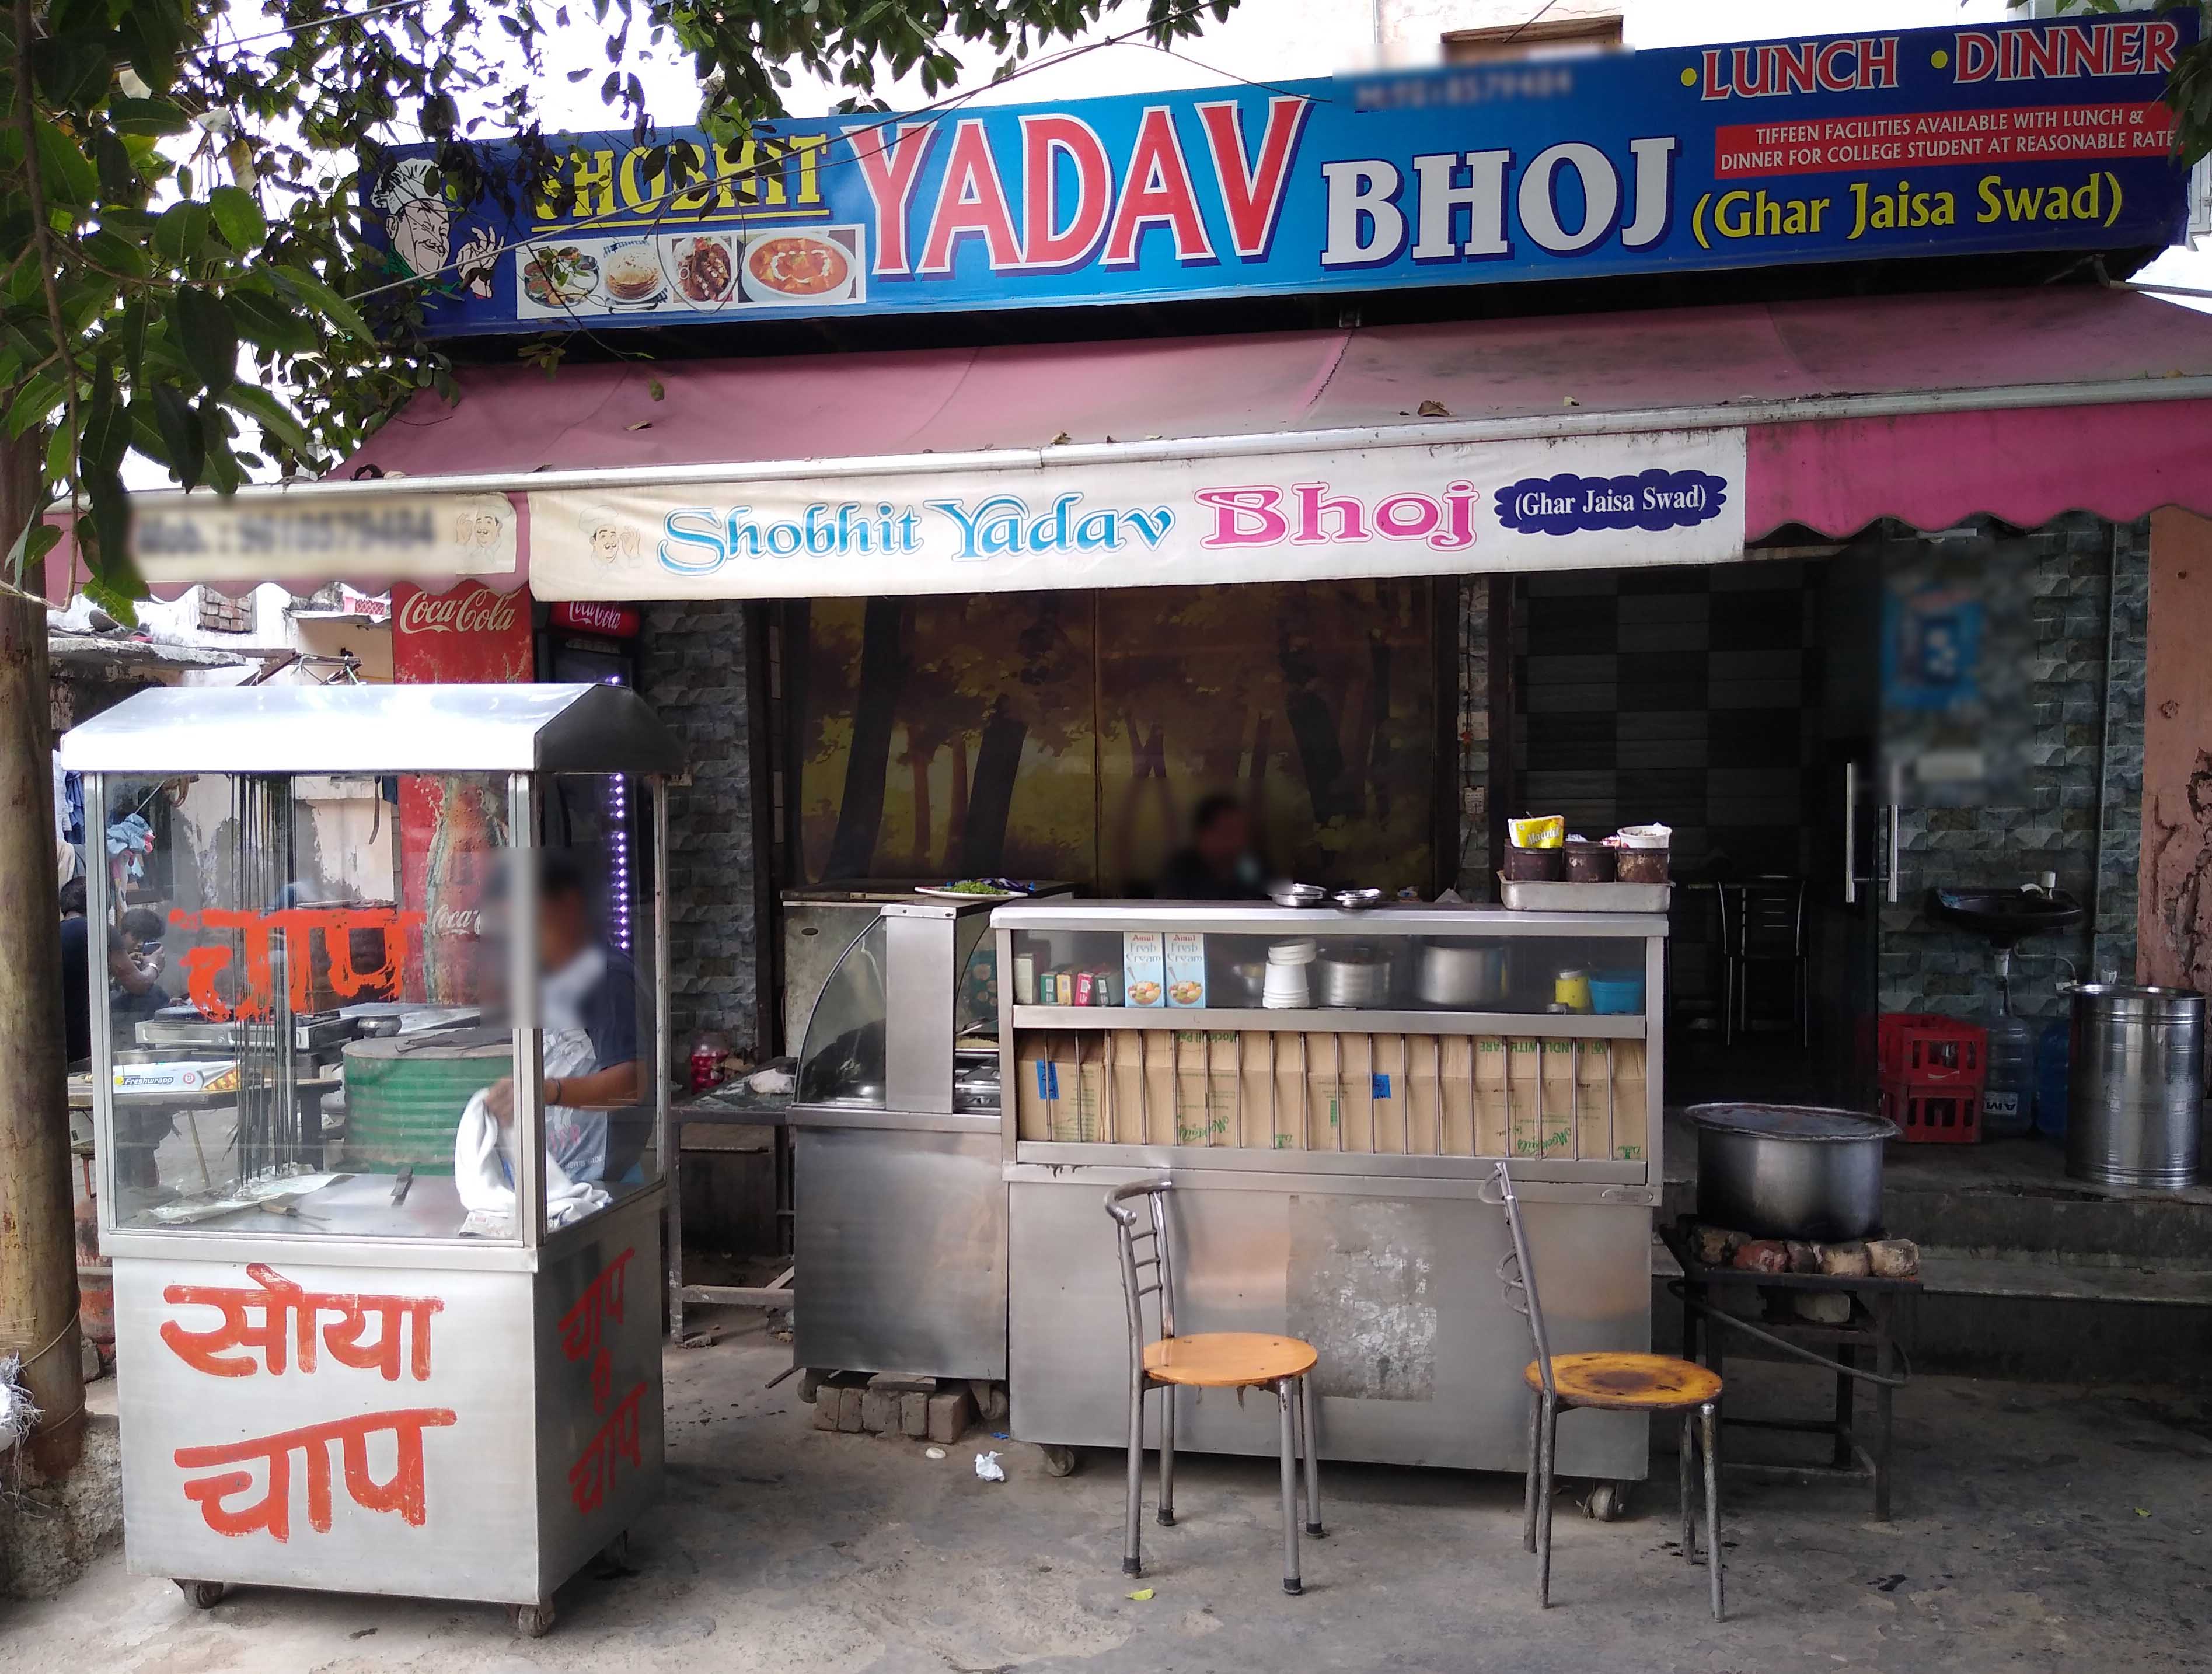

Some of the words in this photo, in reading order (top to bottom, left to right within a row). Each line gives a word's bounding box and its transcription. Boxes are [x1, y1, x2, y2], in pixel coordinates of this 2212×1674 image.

[1700, 36, 1899, 100] LUNCH
[1953, 22, 2179, 83] DINNER
[1721, 151, 1784, 170] DINNER
[1788, 148, 1822, 166] FOR
[1827, 142, 1902, 163] COLLEGE
[1907, 138, 1984, 159] STUDENT
[1987, 137, 2011, 154] AT
[2016, 131, 2126, 152] REASONABLE
[1755, 125, 1820, 145] TIFFEEN
[1825, 118, 1911, 140] FACILITIES
[1915, 113, 2008, 134] AVAILABLE
[2013, 111, 2057, 129] WITH
[2063, 109, 2123, 127] LUNCH
[2129, 110, 2144, 124] &
[839, 94, 1311, 275] YADAV
[1320, 137, 1676, 265] BHOJ
[1691, 190, 1830, 249] (Ghar
[1845, 180, 1955, 240] Jaisa
[1977, 171, 2123, 228] Swad)
[656, 499, 924, 576] Shobhit
[922, 491, 1176, 563] Yadav
[1194, 480, 1480, 552] Bhoj
[1515, 492, 1577, 521] (Ghar
[1582, 488, 1635, 514] Jaisa
[1642, 483, 1707, 512] Swad)
[159, 1262, 445, 1382] सोया
[174, 1407, 458, 1544] चाप
